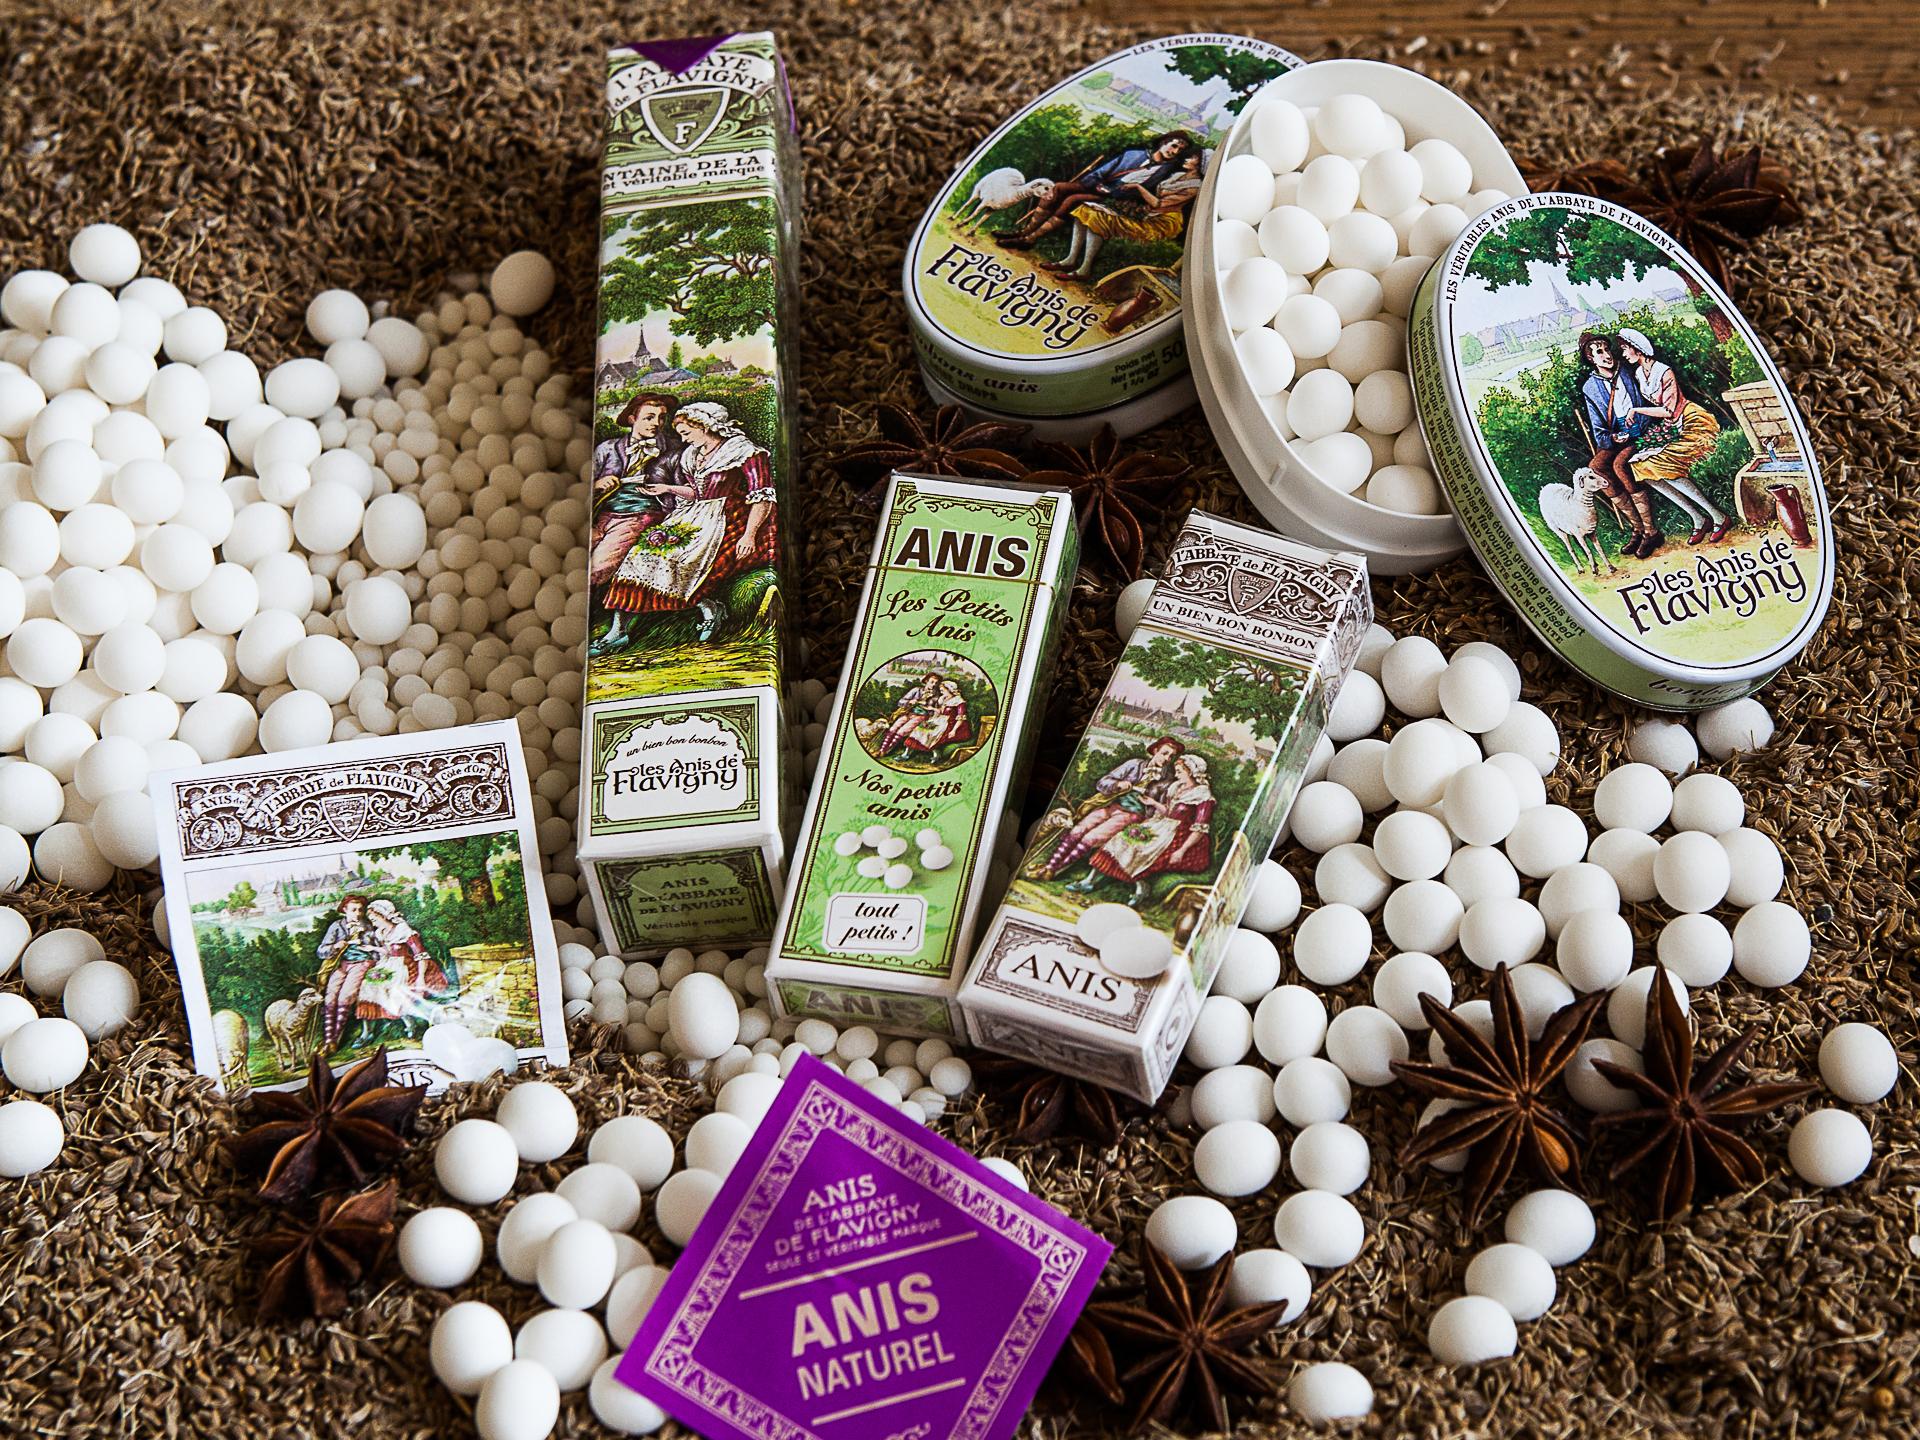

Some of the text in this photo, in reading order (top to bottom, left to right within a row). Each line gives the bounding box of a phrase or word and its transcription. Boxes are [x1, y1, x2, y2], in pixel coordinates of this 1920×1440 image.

[614, 69, 764, 107] de FLAVIGNY
[675, 120, 697, 145] F
[623, 170, 698, 187] véritable
[703, 164, 765, 178] marque
[697, 158, 728, 170] DE
[736, 155, 761, 166] LA
[1446, 195, 1676, 302] LES VÉRITABLES ANIS DE L'ABBAYE DE FLAVIGNY
[926, 244, 1087, 349] Flavigny
[978, 256, 1099, 327] les Anis de
[1114, 358, 1139, 373] Poids
[1161, 340, 1183, 365] 50
[984, 379, 1040, 393] anis
[1413, 329, 1423, 374] BONBON
[1428, 419, 1439, 441] PAS
[1435, 443, 1460, 497] CROQUER
[1462, 506, 1482, 538] HARD
[1480, 539, 1511, 583] SWEETS,
[1510, 582, 1524, 598] DO
[1523, 599, 1542, 619] NOT
[1540, 620, 1564, 645] BITE
[1434, 372, 1446, 409] sucre,
[1443, 408, 1459, 444] arôme
[1455, 445, 1478, 485] naturel
[1473, 487, 1495, 521] d'anis
[1512, 553, 1539, 586] graine
[1538, 586, 1566, 616] d'anis
[1565, 616, 1586, 637] vert
[1427, 381, 1440, 417] sugar,
[1436, 417, 1455, 456] natural
[1450, 458, 1465, 480] star
[1460, 482, 1480, 514] anise
[1477, 513, 1514, 571] flavouring,
[1512, 570, 1539, 601] green
[1536, 601, 1576, 639] aniseed
[893, 527, 1029, 578] ANIS
[1243, 560, 1259, 571] de
[1651, 538, 1793, 594] les Anis de
[878, 588, 1014, 628] Les Petits
[1239, 592, 1253, 607] F
[1616, 561, 1807, 635] Flavigny
[906, 614, 977, 643] Anis
[1152, 600, 1318, 650] UN BIEN BON BONBON
[626, 734, 728, 757] un bien bon bonbon
[613, 766, 738, 795] Flavigny
[639, 754, 738, 777] les Anis de
[200, 795, 232, 811] ANIS
[329, 776, 344, 788] de
[346, 773, 423, 793] FLAVIGNY
[464, 764, 486, 776] d'Or
[843, 769, 963, 804] Nos petits
[866, 803, 933, 821] amis
[659, 886, 740, 901] L'ABBAYE
[661, 877, 709, 889] ANIS
[643, 915, 748, 930] Véritable marque
[661, 897, 746, 914] FLAVIGNY
[854, 902, 900, 918] tout
[838, 923, 898, 946] petits
[1008, 953, 1122, 1003] ANIS
[802, 1173, 877, 1214] ANIS
[774, 1203, 921, 1257] DE FLAVIGNY
[793, 1193, 900, 1233] DE L'ABBAYE
[765, 1255, 801, 1275] SEULE
[807, 1250, 821, 1263] ET
[893, 1217, 942, 1240] MARQUE
[791, 1271, 941, 1358] ANIS
[796, 1330, 956, 1401] NATUREL
